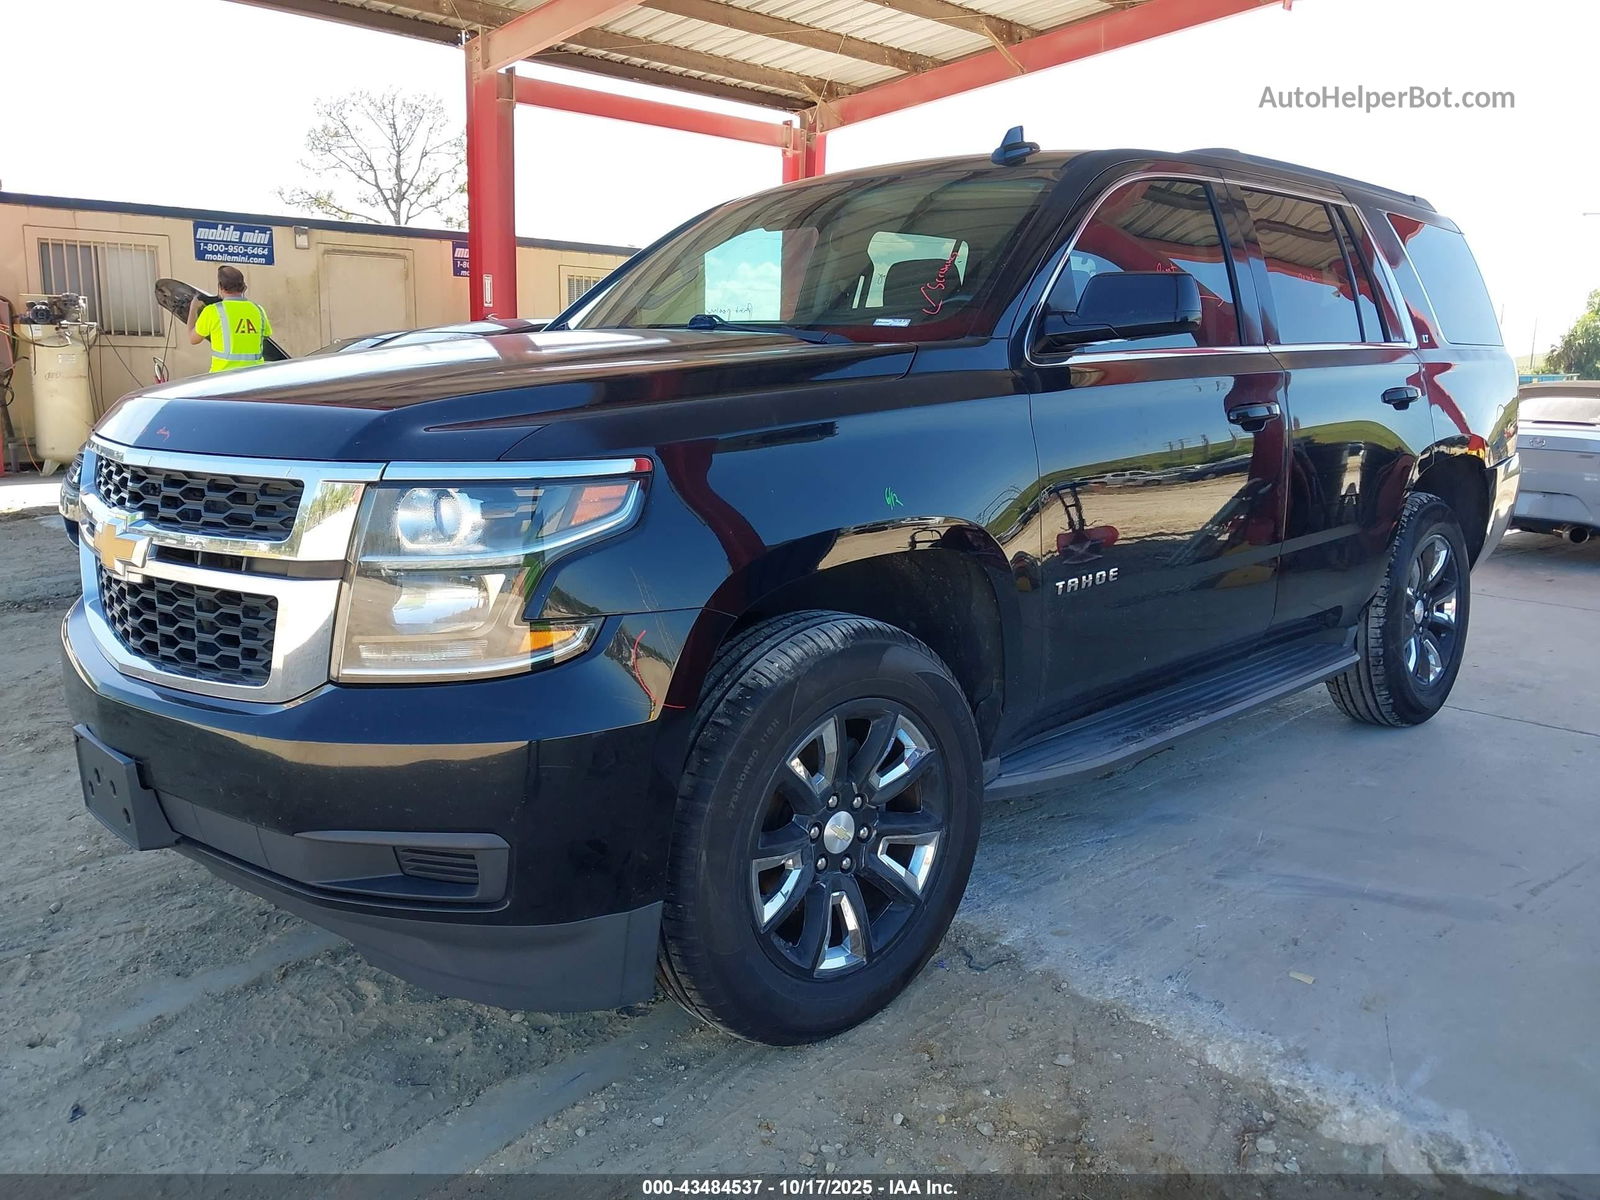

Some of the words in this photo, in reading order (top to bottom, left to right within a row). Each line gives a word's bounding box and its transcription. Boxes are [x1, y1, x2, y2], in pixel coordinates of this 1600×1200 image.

[196, 224, 240, 242] mobile
[241, 230, 272, 244] mini
[199, 242, 268, 255] 1-800-950-6464
[204, 253, 266, 264] mobilemini.com
[1055, 567, 1119, 596] TAHOE
